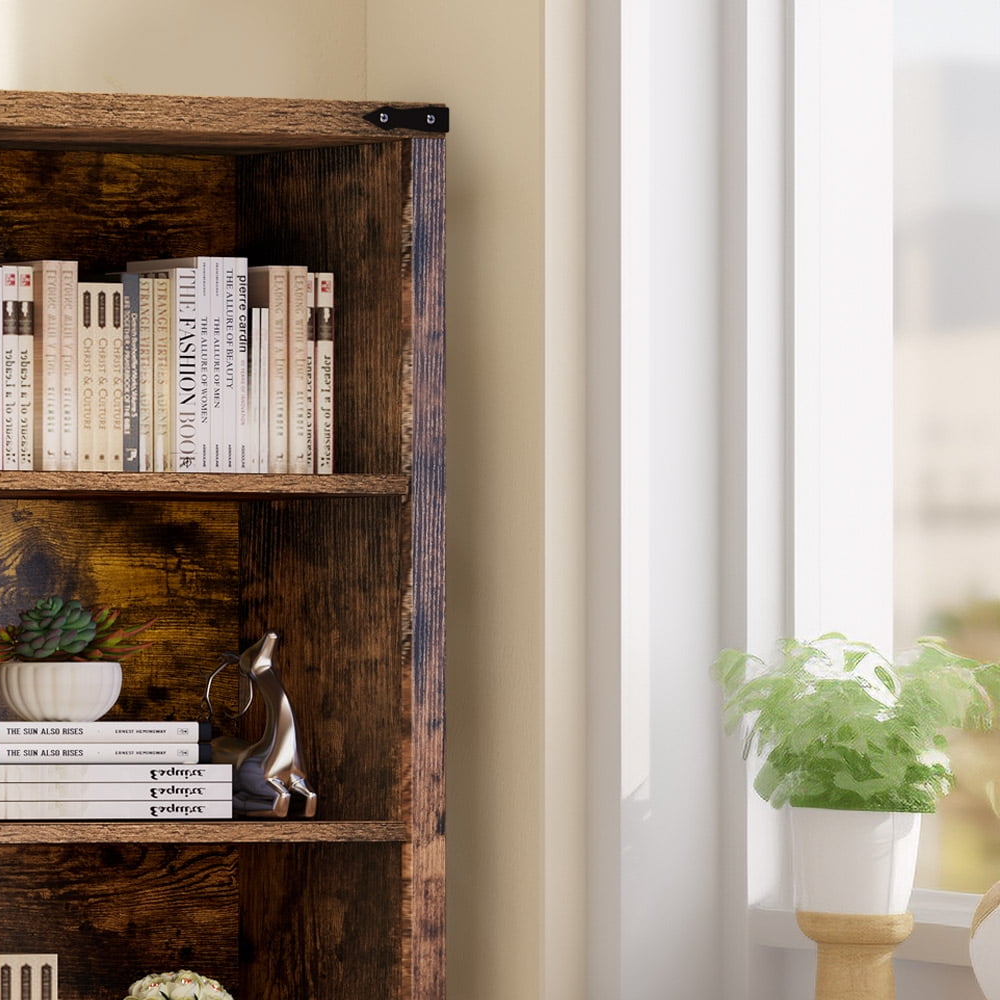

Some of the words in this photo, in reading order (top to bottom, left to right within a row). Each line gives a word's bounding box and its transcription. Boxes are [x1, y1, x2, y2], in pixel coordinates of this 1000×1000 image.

[178, 270, 196, 312] THE
[226, 269, 234, 290] THE
[237, 275, 248, 310] pierre
[200, 317, 208, 336] THE
[226, 292, 234, 332] ALLURE
[226, 333, 234, 346] OF
[239, 314, 248, 352] cardin
[178, 318, 196, 405] FASHION
[200, 337, 208, 372] ALLURE
[226, 349, 234, 390] BEAUTY
[200, 374, 208, 386] OF
[214, 374, 220, 386] OF
[320, 355, 332, 392] Leader
[200, 388, 208, 424] WOMEN
[320, 407, 332, 418] of
